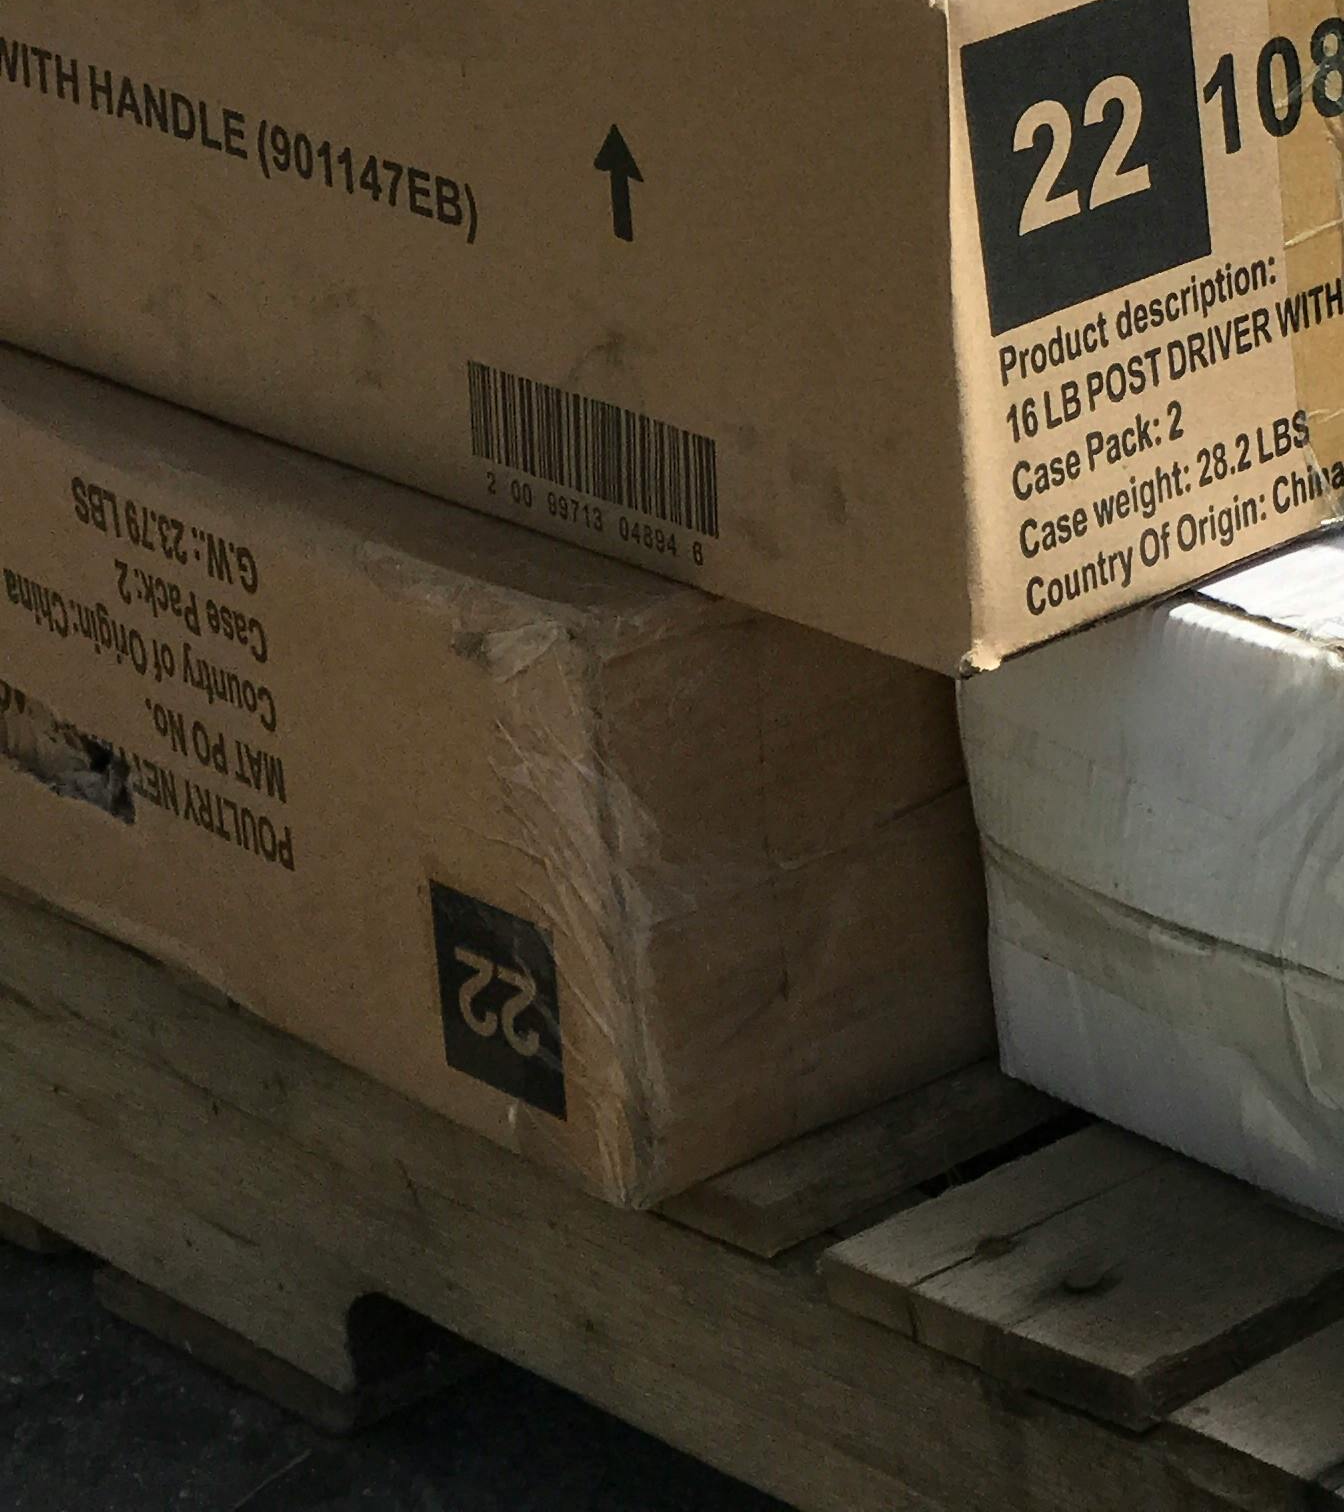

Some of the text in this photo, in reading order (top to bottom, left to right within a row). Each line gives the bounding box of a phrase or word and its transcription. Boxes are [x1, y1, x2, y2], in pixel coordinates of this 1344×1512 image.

[88, 64, 249, 159] HANDLE
[257, 118, 478, 244] (901147EB)
[1011, 74, 1154, 237] 22
[999, 255, 1277, 387] Product description:
[1006, 396, 1040, 444] 16
[1043, 380, 1083, 430] LB
[1086, 347, 1162, 412] POST
[1166, 306, 1273, 381] DRIVER
[487, 471, 497, 496] 2
[510, 479, 533, 508] 00
[547, 491, 604, 532] 99713
[1012, 400, 1185, 502] Case Pack: 2
[1019, 408, 1311, 560] Case weight: 28.2 LBS
[70, 476, 259, 595] G.W.: 23.79 LBS
[1025, 545, 1134, 616] Country
[1139, 519, 1171, 568] Of
[1176, 494, 1267, 547] Origin:
[3, 568, 277, 733] Country of Origin: China
[113, 558, 268, 664] Case Pack: 2
[144, 697, 287, 805] MAT PO No.
[182, 779, 296, 872] POULTRY
[454, 946, 540, 1057] 22
